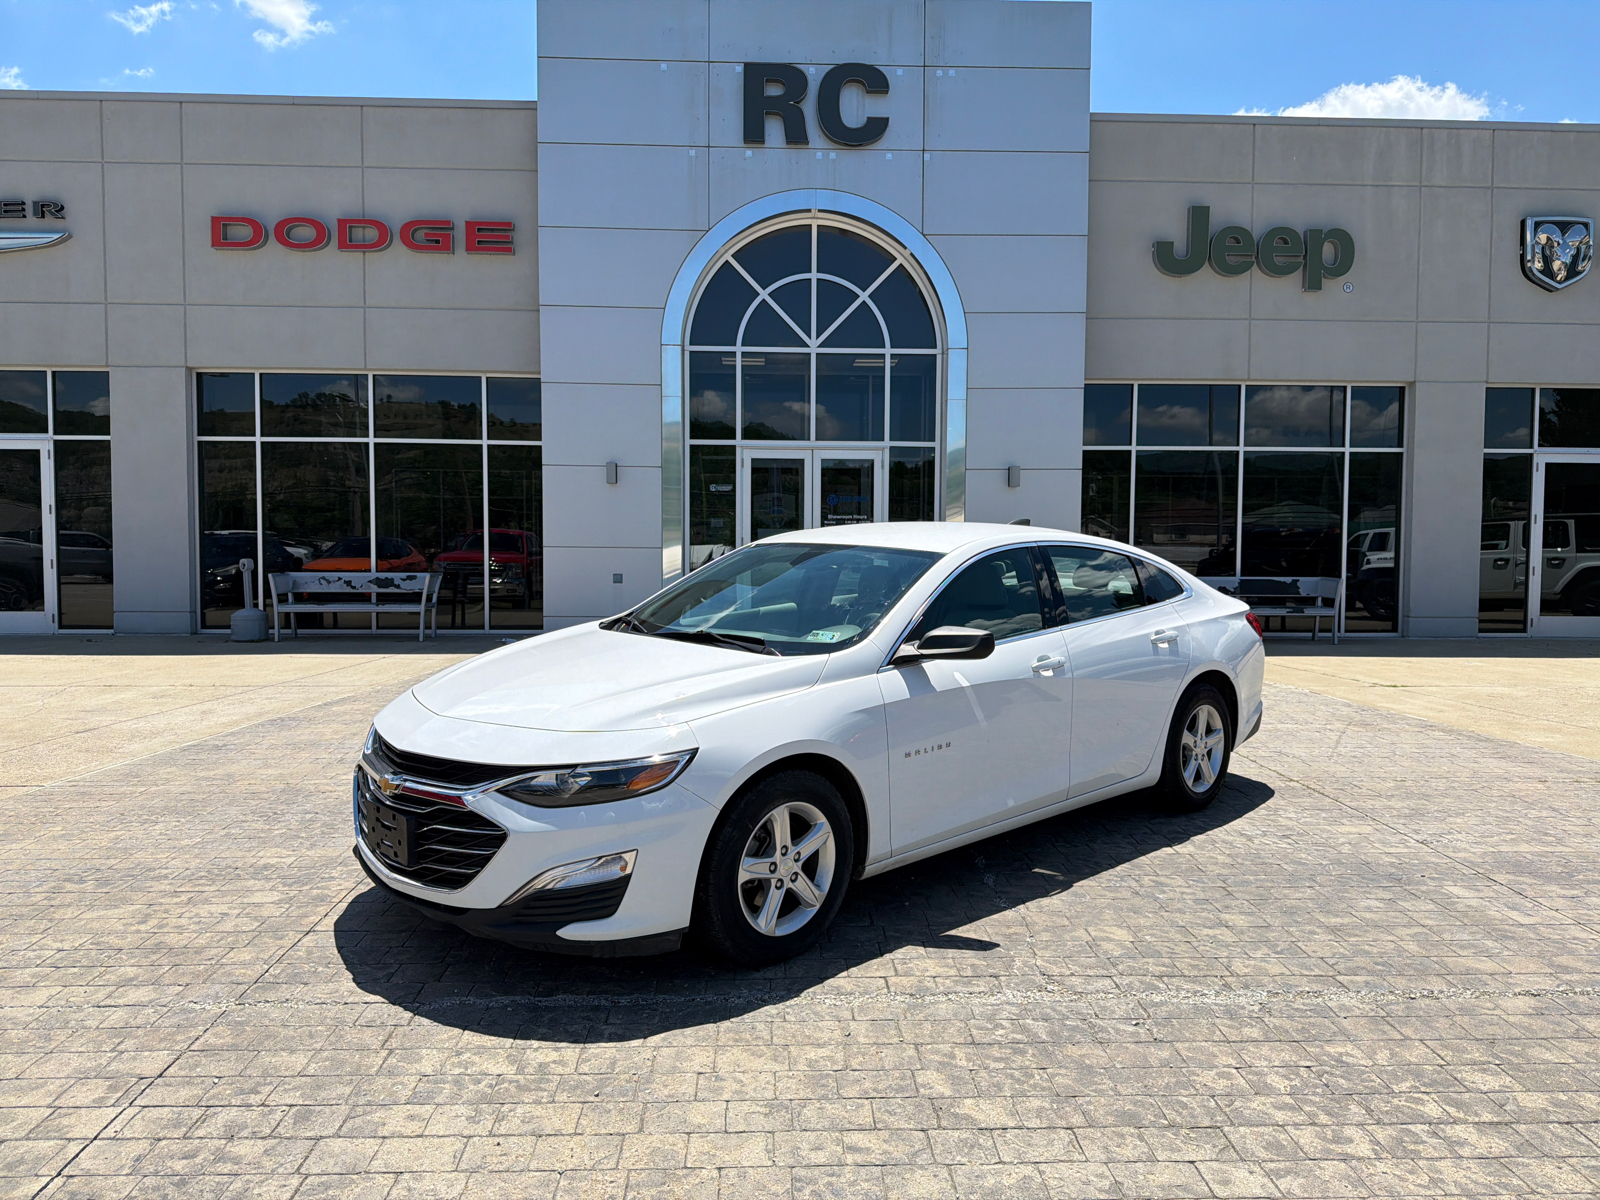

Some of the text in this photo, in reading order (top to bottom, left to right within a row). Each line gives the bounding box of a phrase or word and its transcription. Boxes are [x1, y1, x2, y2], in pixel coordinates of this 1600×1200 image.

[743, 62, 890, 147] RC
[210, 215, 515, 254] DODGE
[1153, 205, 1354, 292] Jeep
[904, 741, 952, 759] MALIBU
